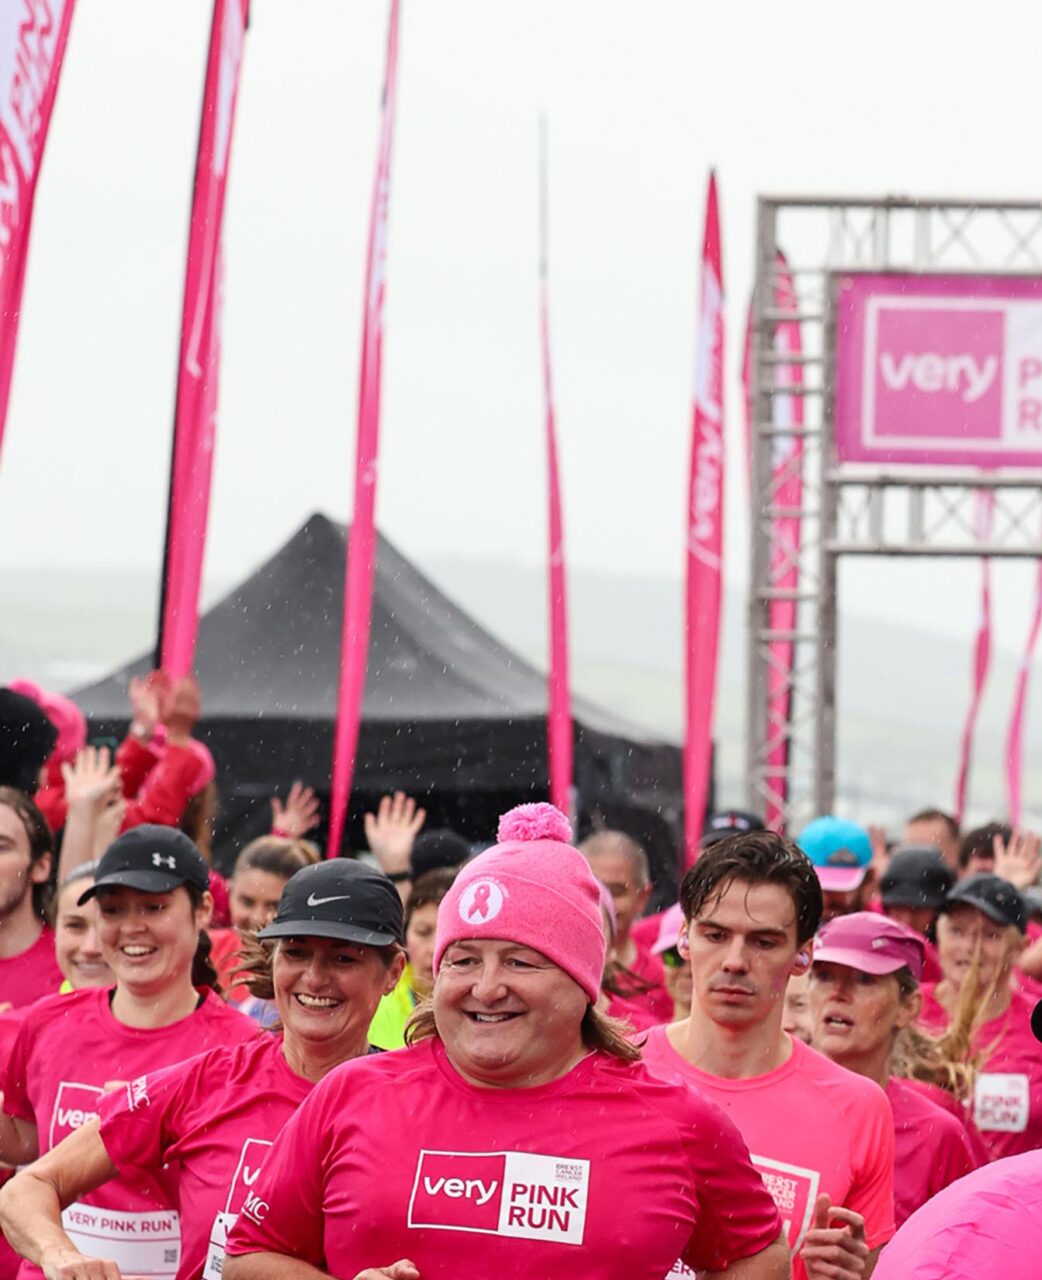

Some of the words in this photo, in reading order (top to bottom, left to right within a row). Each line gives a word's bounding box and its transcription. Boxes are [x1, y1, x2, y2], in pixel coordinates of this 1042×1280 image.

[879, 351, 999, 403] very
[57, 1107, 100, 1129] ver
[424, 1176, 498, 1206] very
[511, 1183, 580, 1209] PINK
[68, 1210, 98, 1227] VERY
[100, 1217, 136, 1232] PINK
[140, 1219, 172, 1233] RUN
[508, 1205, 571, 1232] RUN
